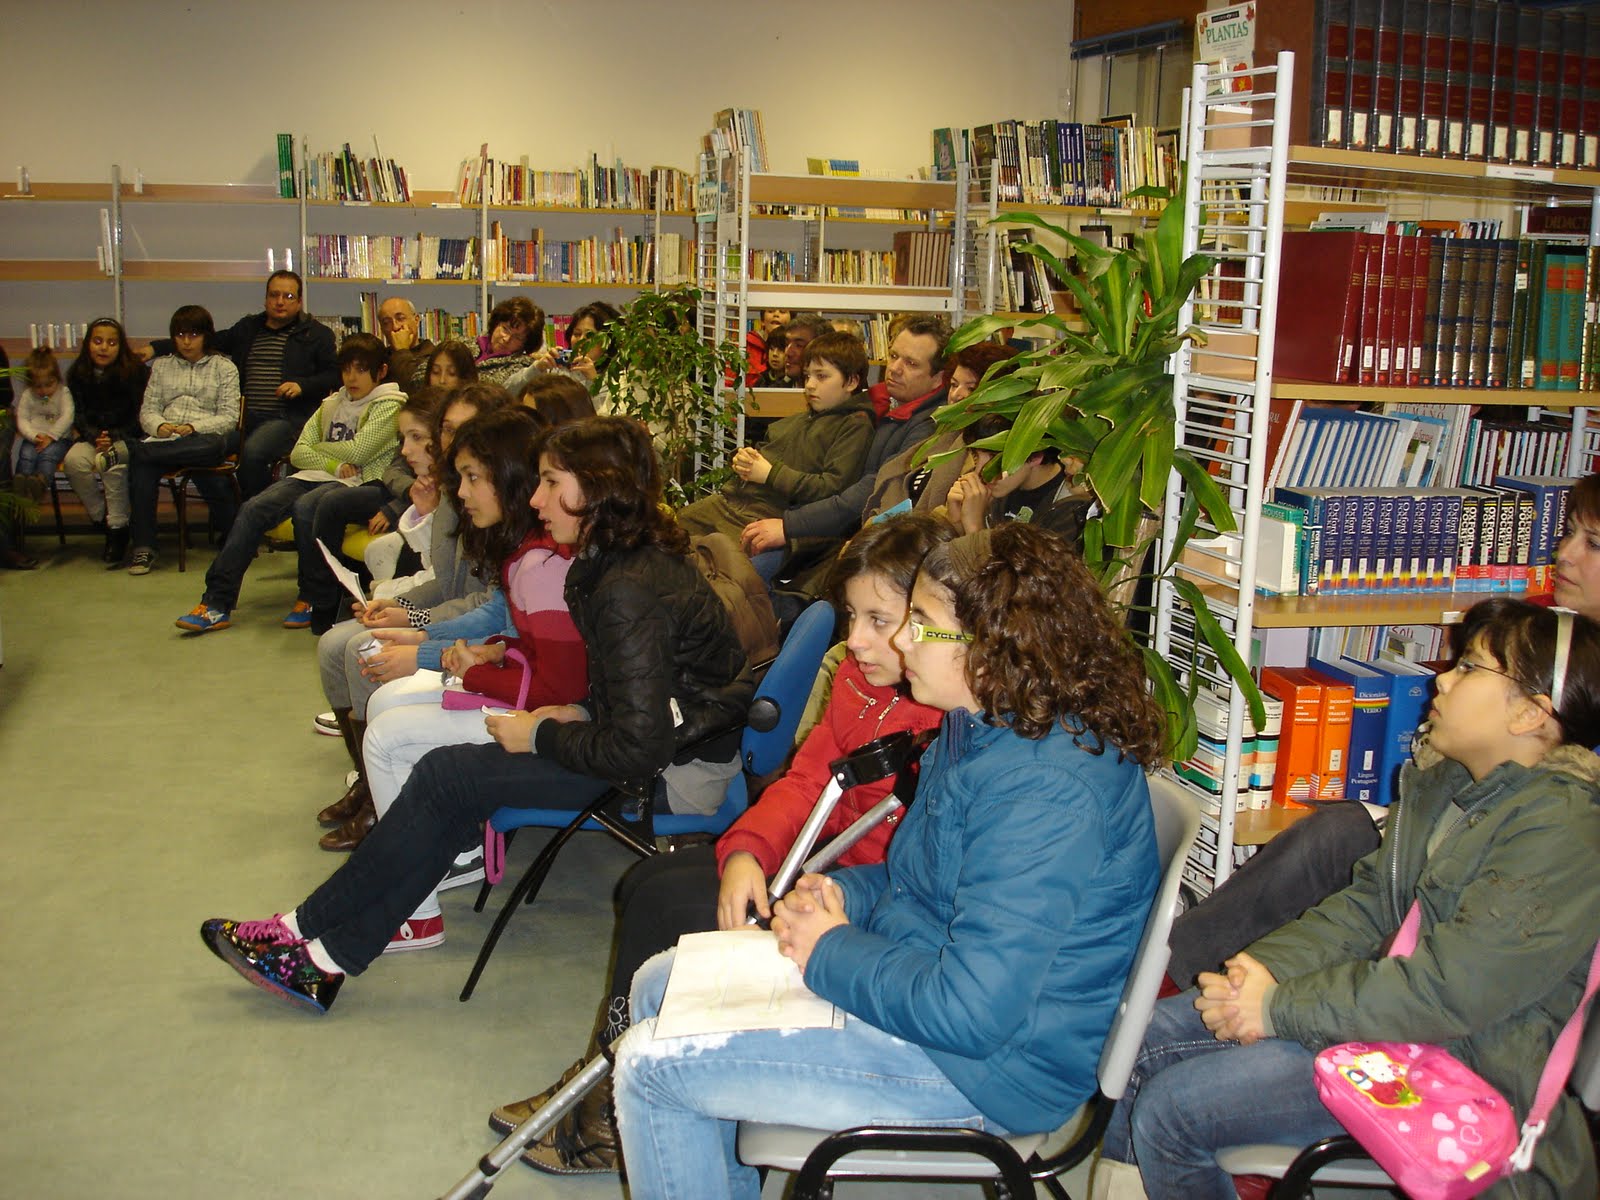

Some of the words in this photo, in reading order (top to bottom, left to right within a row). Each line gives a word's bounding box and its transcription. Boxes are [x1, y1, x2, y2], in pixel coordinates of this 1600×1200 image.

[1205, 20, 1249, 44] PLANTAS
[1544, 215, 1588, 230] DIDACT
[1263, 507, 1285, 520] ROUSSE
[1331, 502, 1340, 535] Oxford
[1348, 502, 1358, 534] Oxford
[1365, 502, 1375, 534] Oxford
[1383, 502, 1393, 535] Oxford
[1400, 502, 1410, 534] Oxford
[1417, 502, 1427, 534] Oxford
[1434, 502, 1443, 534] Oxford
[1450, 502, 1460, 534] Oxford
[1460, 506, 1470, 547] POCKET
[1468, 506, 1478, 549] OXFORD
[1480, 507, 1489, 547] POCKET
[1486, 506, 1496, 549] OXFORD
[1497, 506, 1508, 547] POCKET
[1505, 506, 1515, 547] OXFORD
[1516, 506, 1527, 547] POCKET
[1524, 506, 1534, 546] OXFORD
[1539, 492, 1554, 550] LONGMAN
[1556, 490, 1569, 537] LONGMAN
[926, 631, 963, 640] CYCLE
